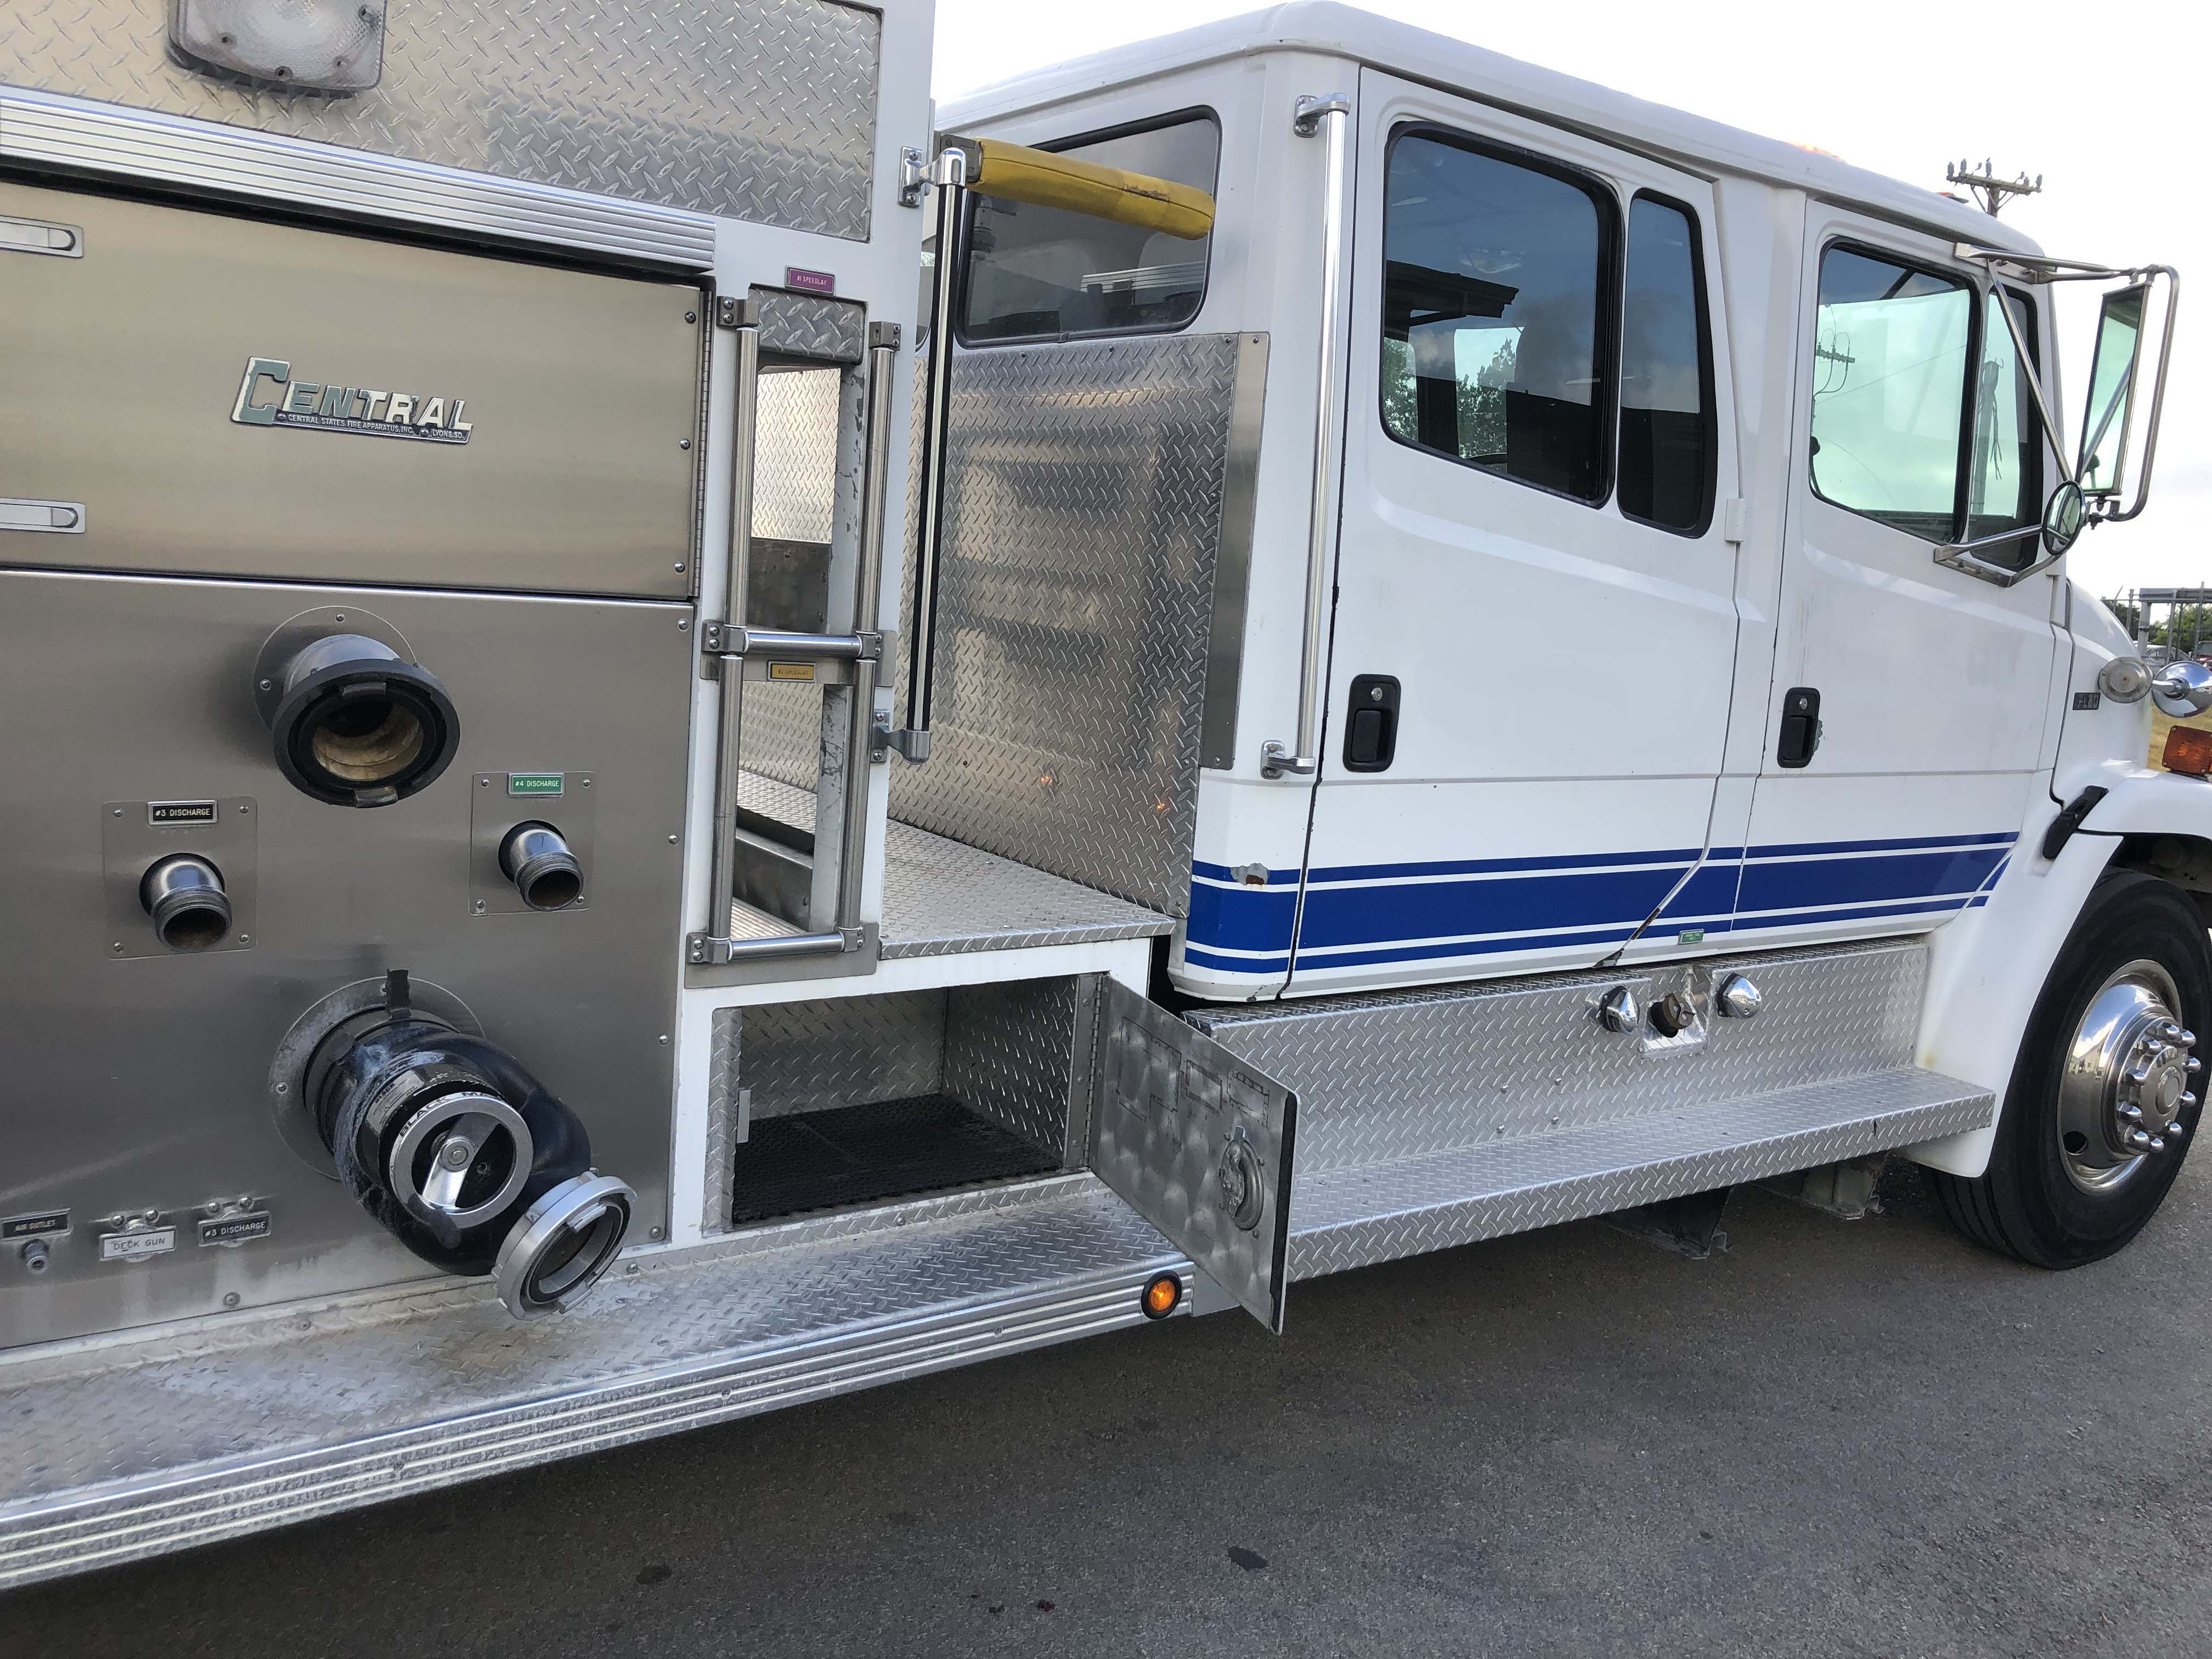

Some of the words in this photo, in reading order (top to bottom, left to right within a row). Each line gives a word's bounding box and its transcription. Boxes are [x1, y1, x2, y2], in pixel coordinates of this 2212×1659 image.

[803, 276, 827, 286] SPEEDLAY
[231, 356, 474, 429] CENTRAL
[288, 414, 319, 425] CENTRAL
[321, 417, 345, 427] STATES
[347, 420, 362, 428] FIRE
[170, 808, 211, 816] DISCHARGE
[205, 1228, 217, 1237] #3
[221, 1221, 266, 1235] DISCHARGE
[114, 1240, 140, 1251] DECK
[145, 1237, 166, 1246] GUN
